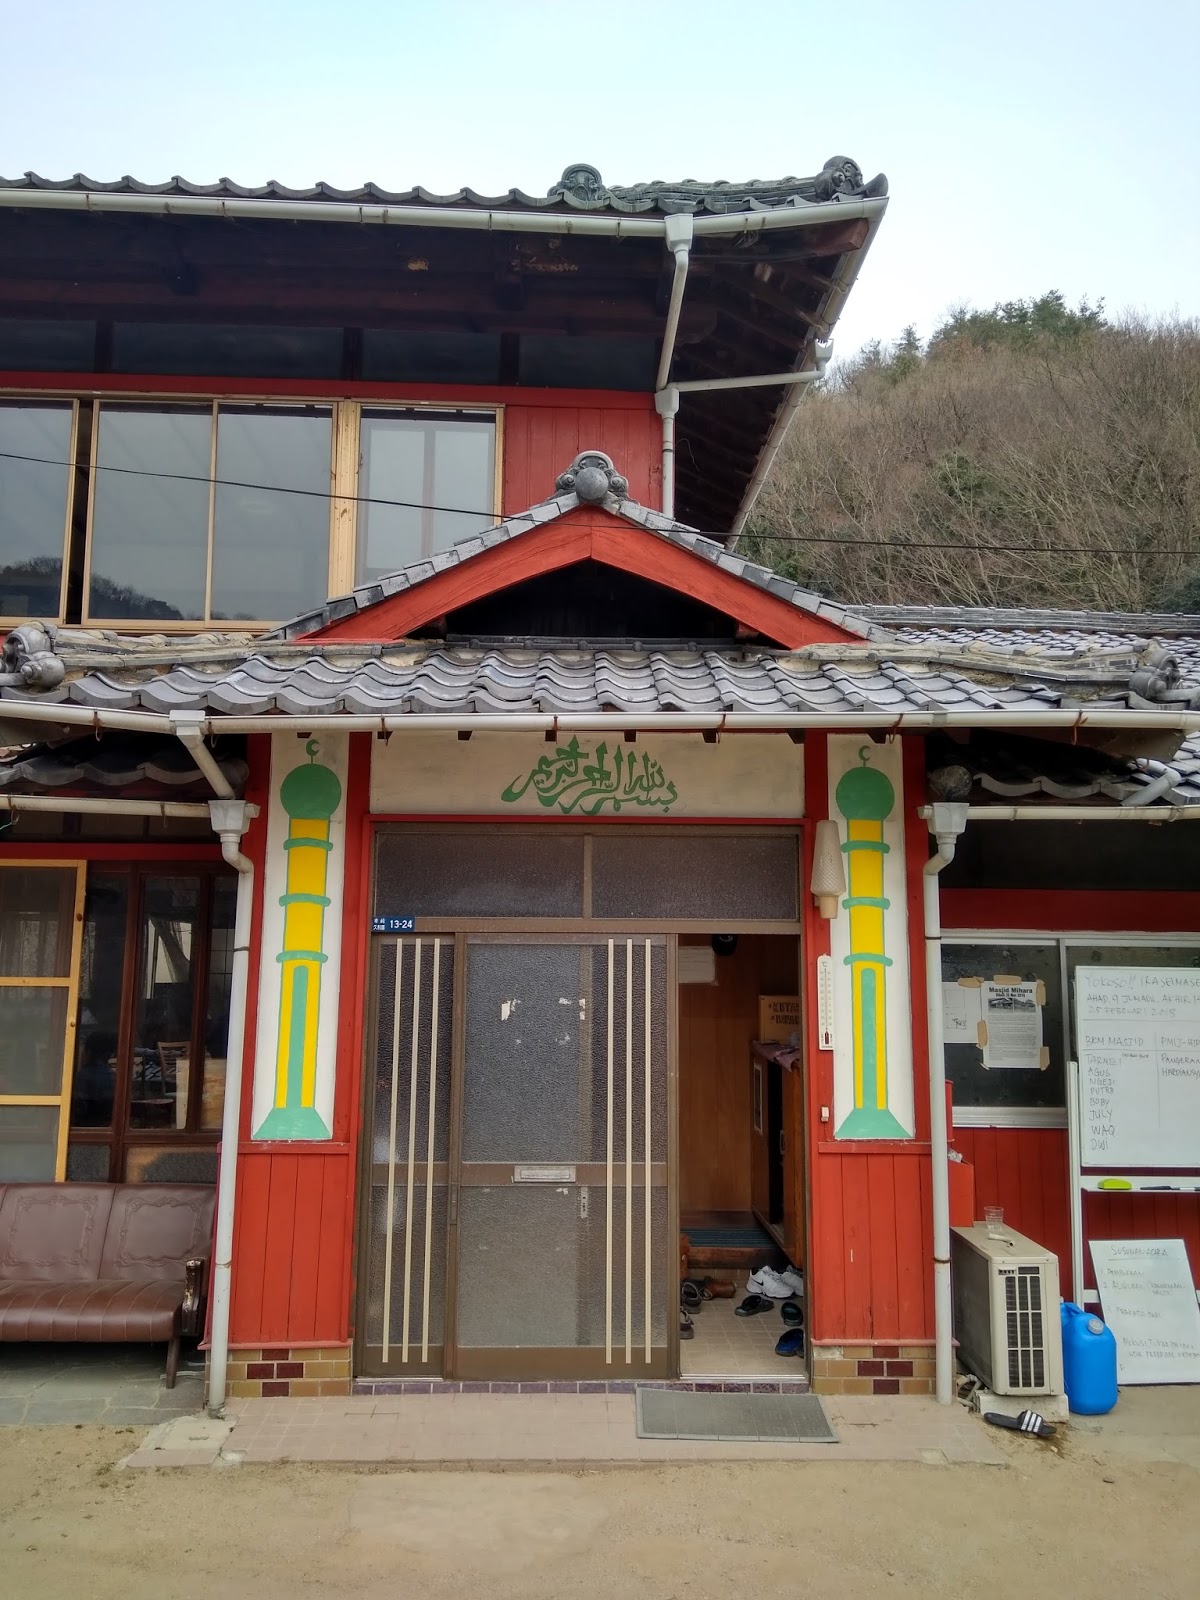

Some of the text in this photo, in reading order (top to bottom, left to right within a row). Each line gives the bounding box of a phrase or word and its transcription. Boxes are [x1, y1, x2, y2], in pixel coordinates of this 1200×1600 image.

[390, 919, 413, 929] 13-24
[988, 986, 1010, 995] Masjid
[1088, 1109, 1112, 1122] JULY
